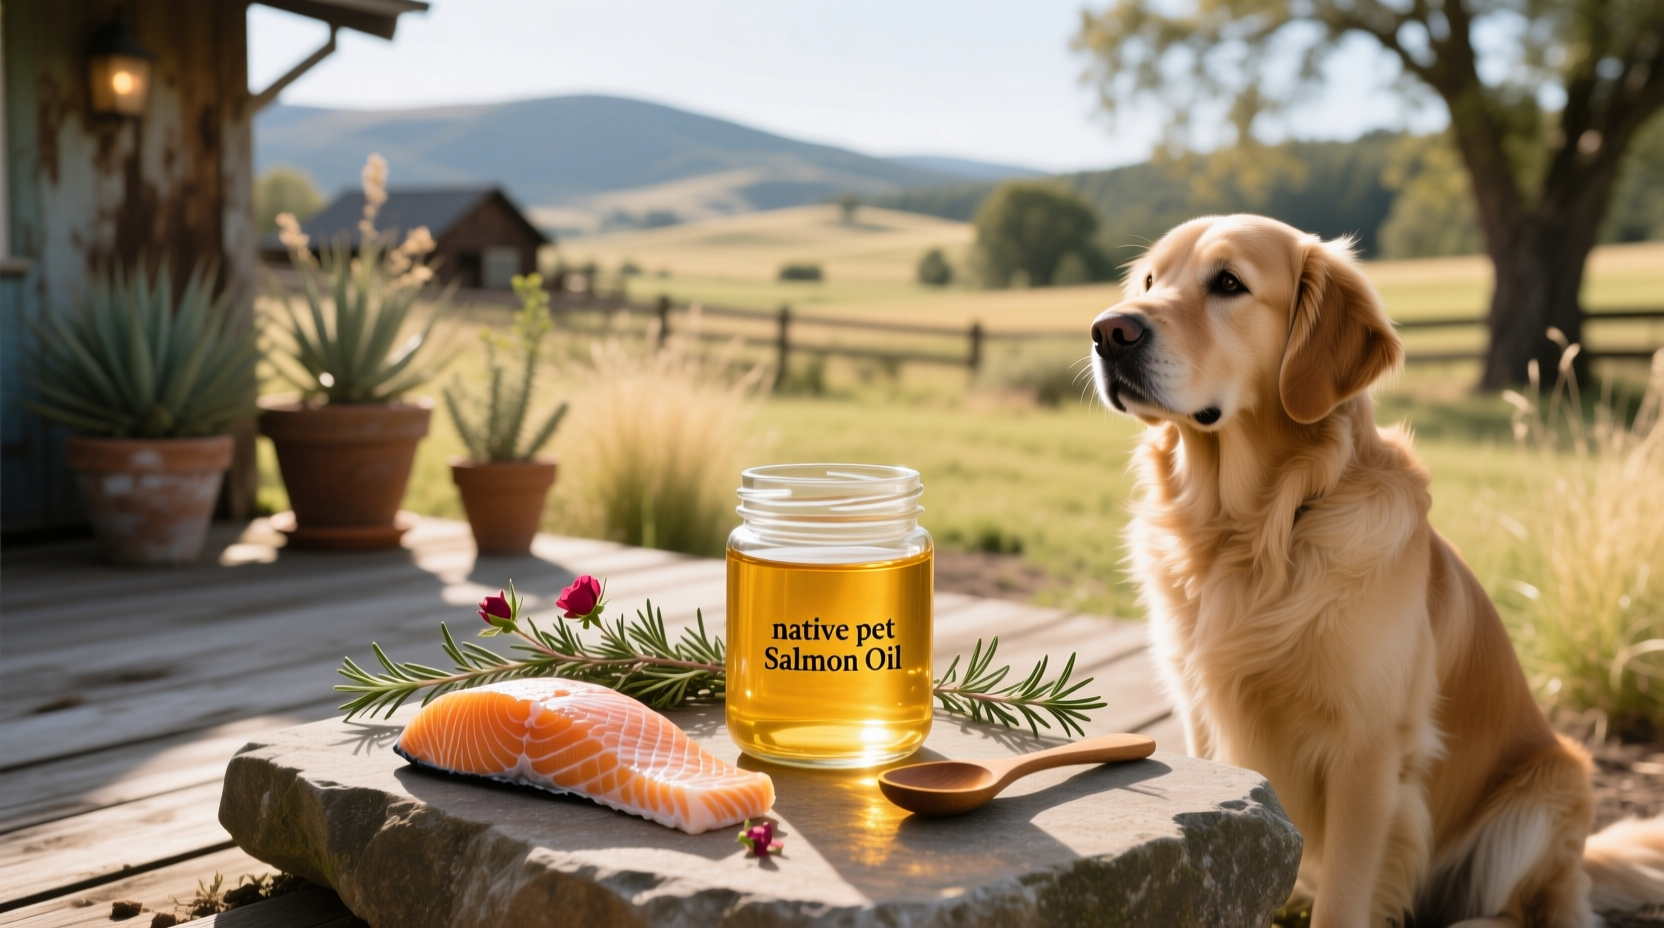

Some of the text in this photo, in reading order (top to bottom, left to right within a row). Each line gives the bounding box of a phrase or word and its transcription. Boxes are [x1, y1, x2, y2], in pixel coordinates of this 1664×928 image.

[771, 617, 896, 647] native pet
[764, 644, 902, 671] Salmon Oil
